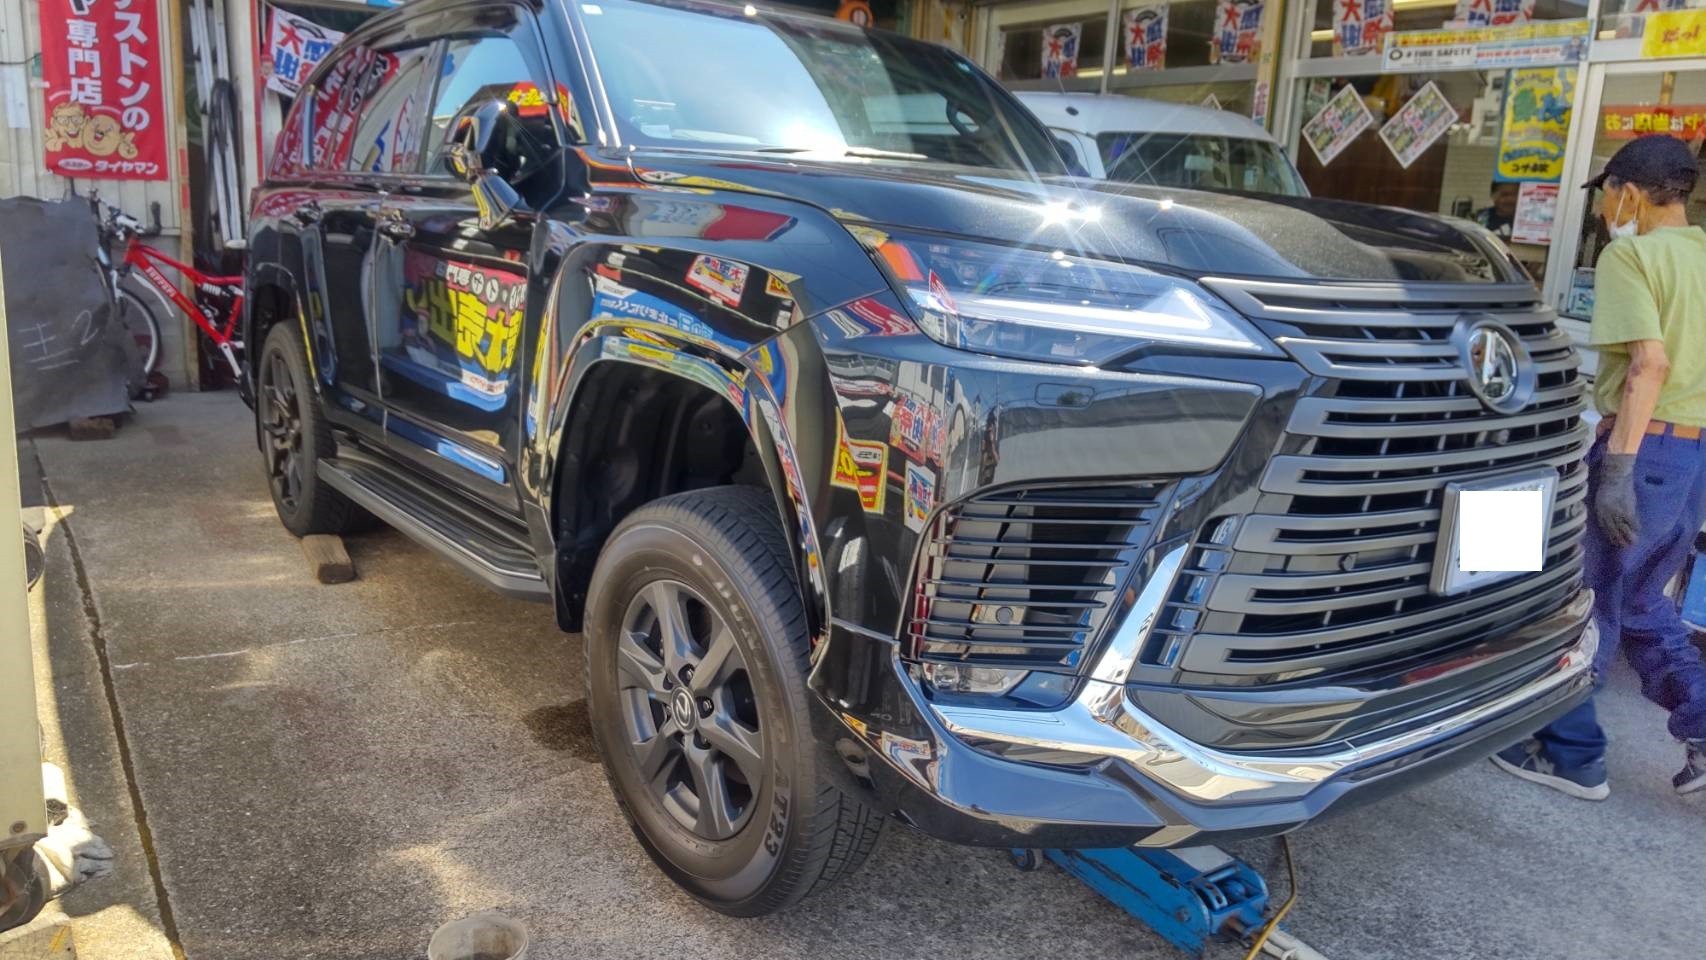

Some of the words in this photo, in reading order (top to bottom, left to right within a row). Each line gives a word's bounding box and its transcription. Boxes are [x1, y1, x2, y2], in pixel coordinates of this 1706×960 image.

[113, 0, 150, 131] ストンの
[95, 160, 158, 175] タイヤマン
[764, 760, 792, 857] AT23
